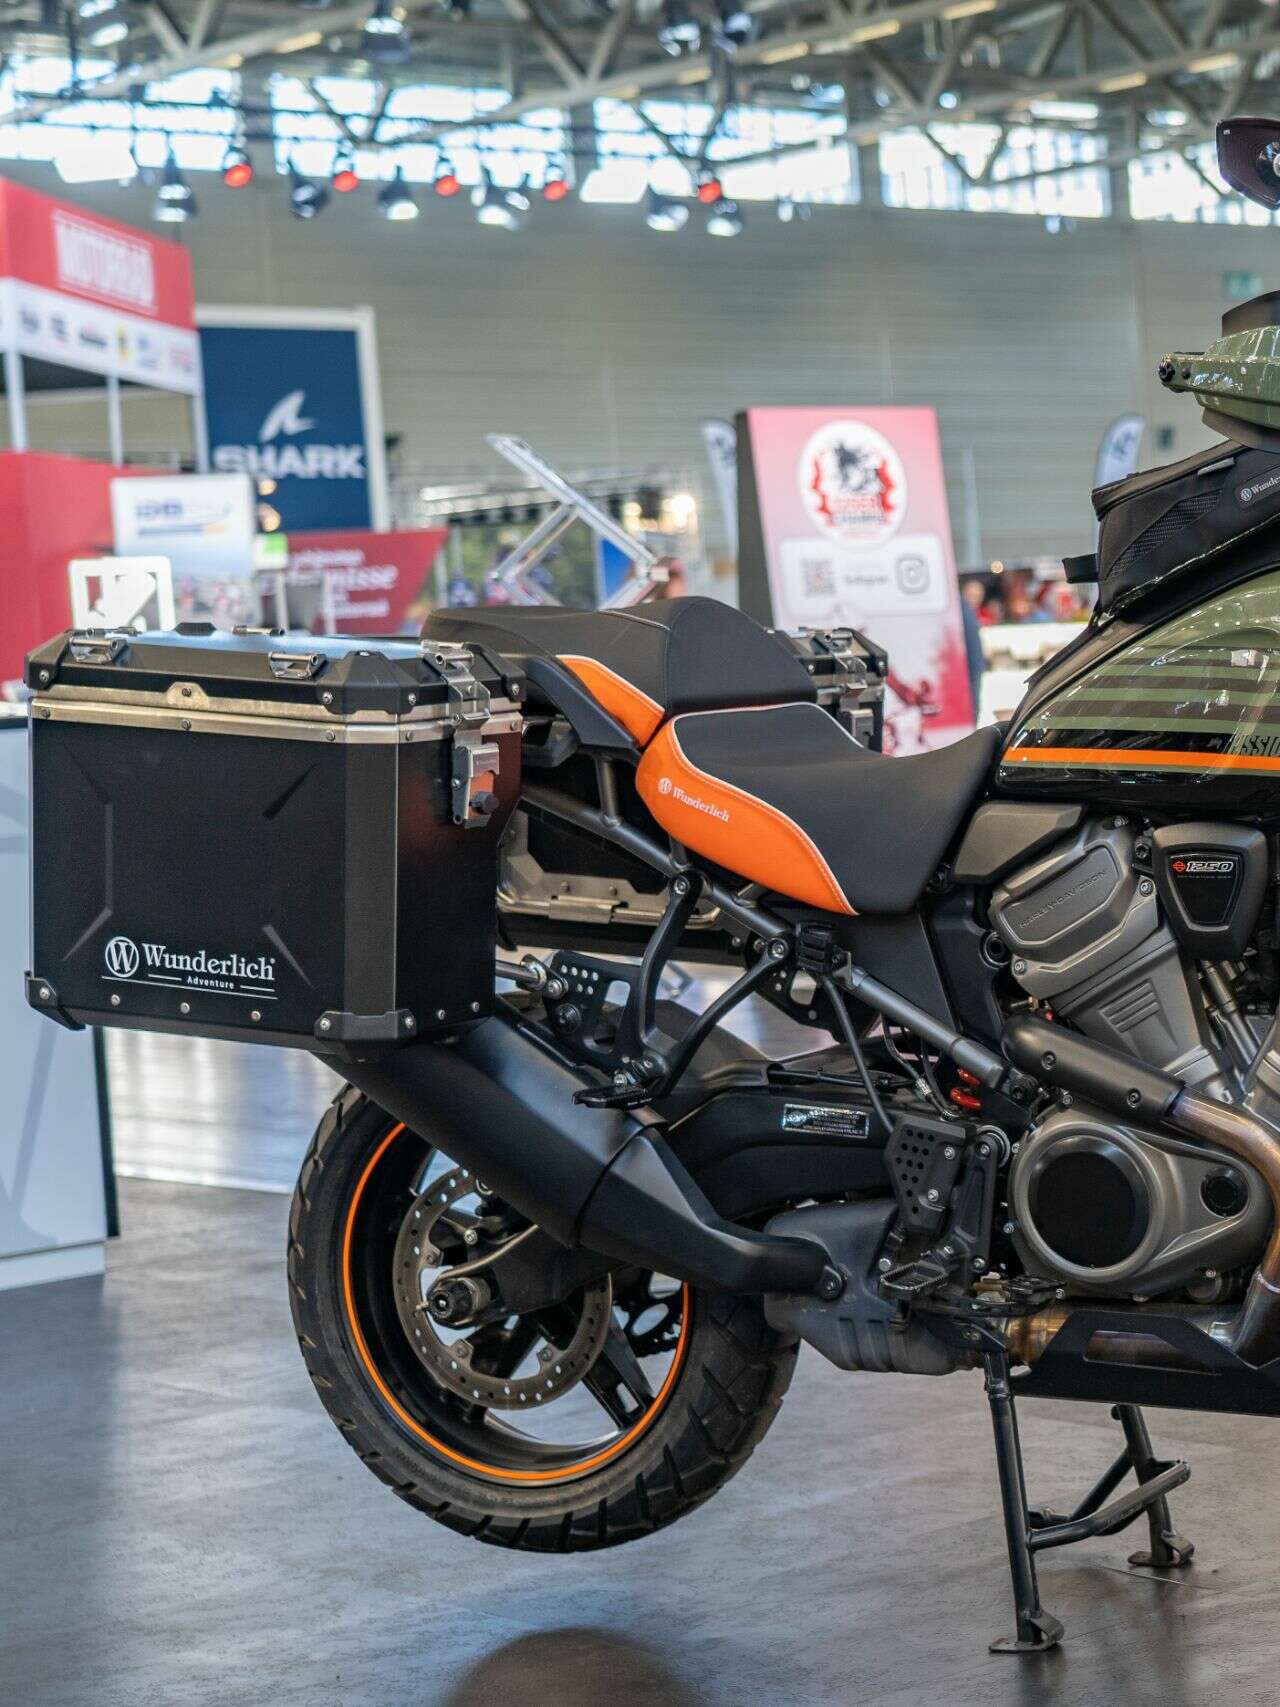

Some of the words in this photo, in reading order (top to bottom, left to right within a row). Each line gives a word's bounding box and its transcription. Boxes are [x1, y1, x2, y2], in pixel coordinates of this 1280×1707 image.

[211, 444, 365, 480] SHARK
[673, 787, 730, 823] Wunderlich
[1186, 861, 1234, 873] 1250
[142, 942, 276, 981] Wunderlich
[187, 975, 236, 990] Adventure
